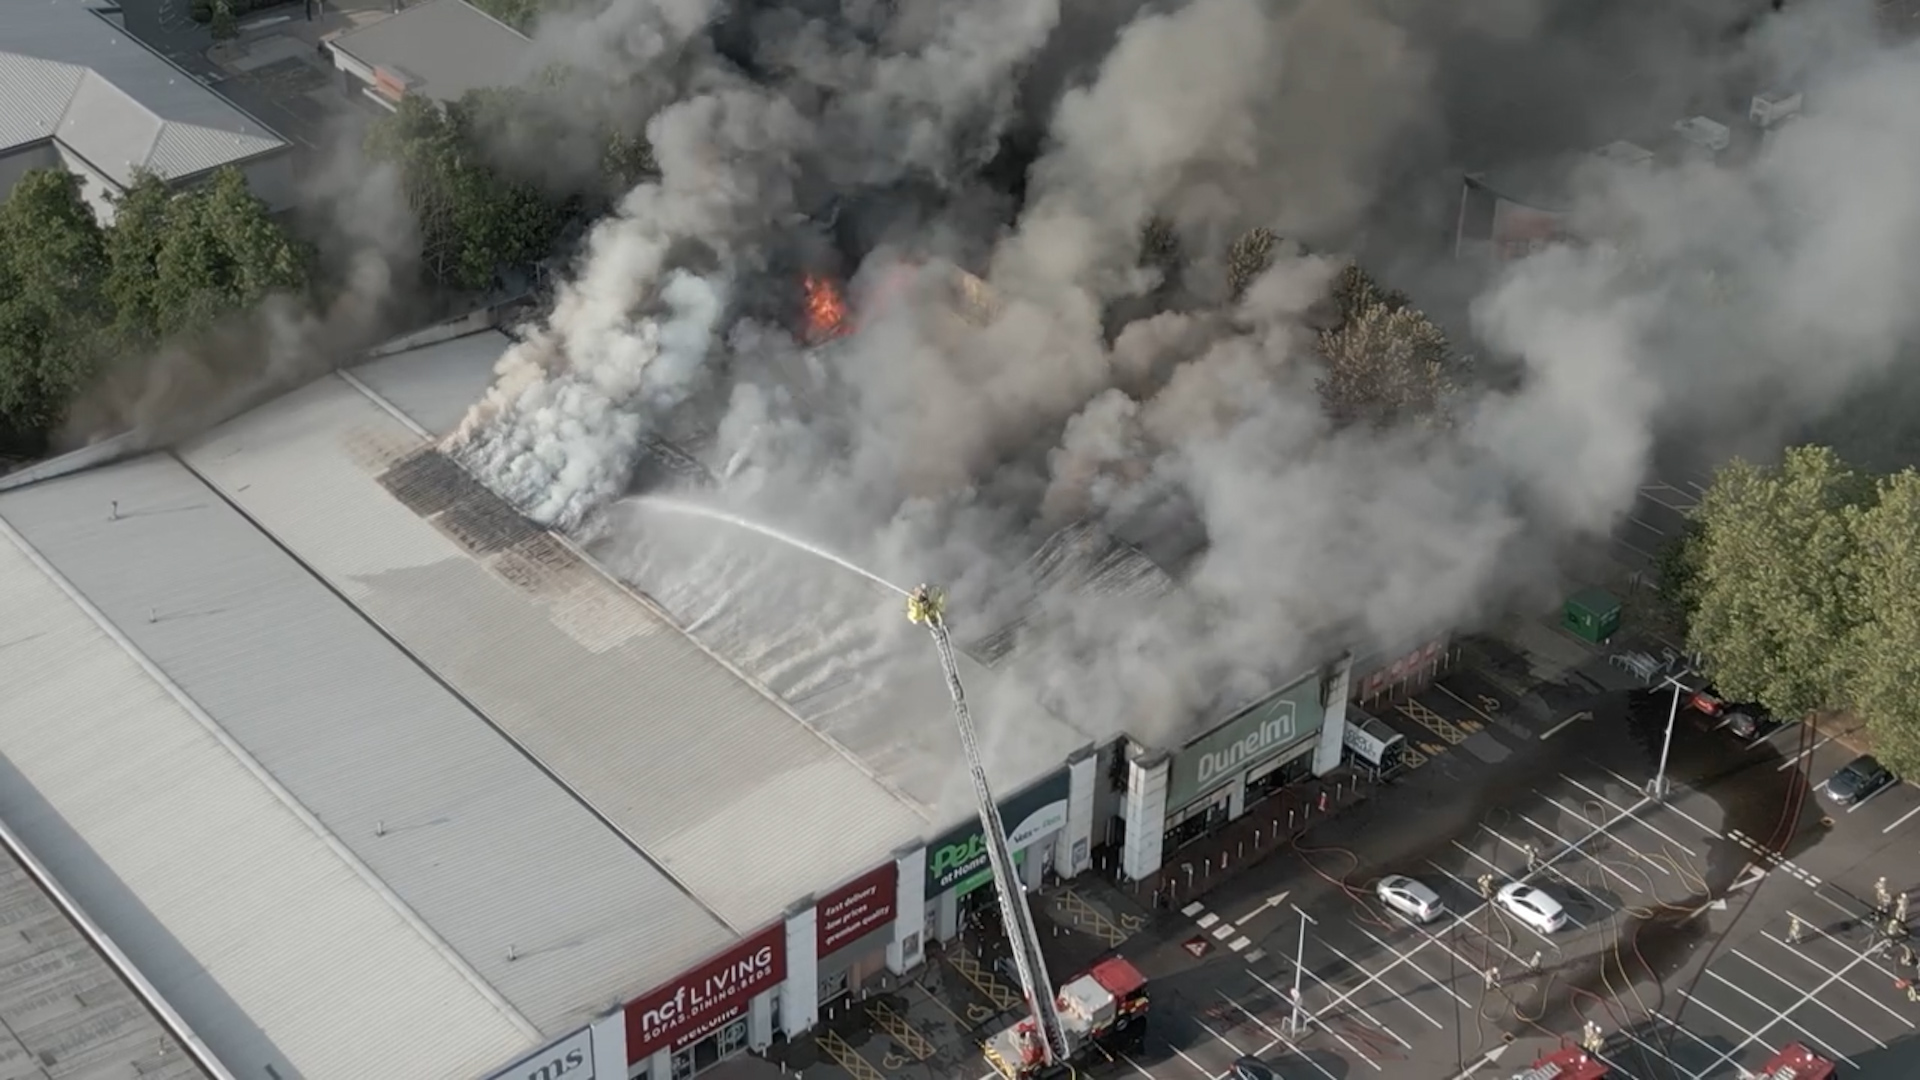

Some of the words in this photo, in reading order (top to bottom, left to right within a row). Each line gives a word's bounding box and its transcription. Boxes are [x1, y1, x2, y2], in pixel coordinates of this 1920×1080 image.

[1197, 713, 1291, 783] Dunelm
[940, 870, 953, 886] at
[953, 853, 987, 878] Home
[642, 985, 686, 1032] ncf
[690, 945, 772, 1005] LIVING
